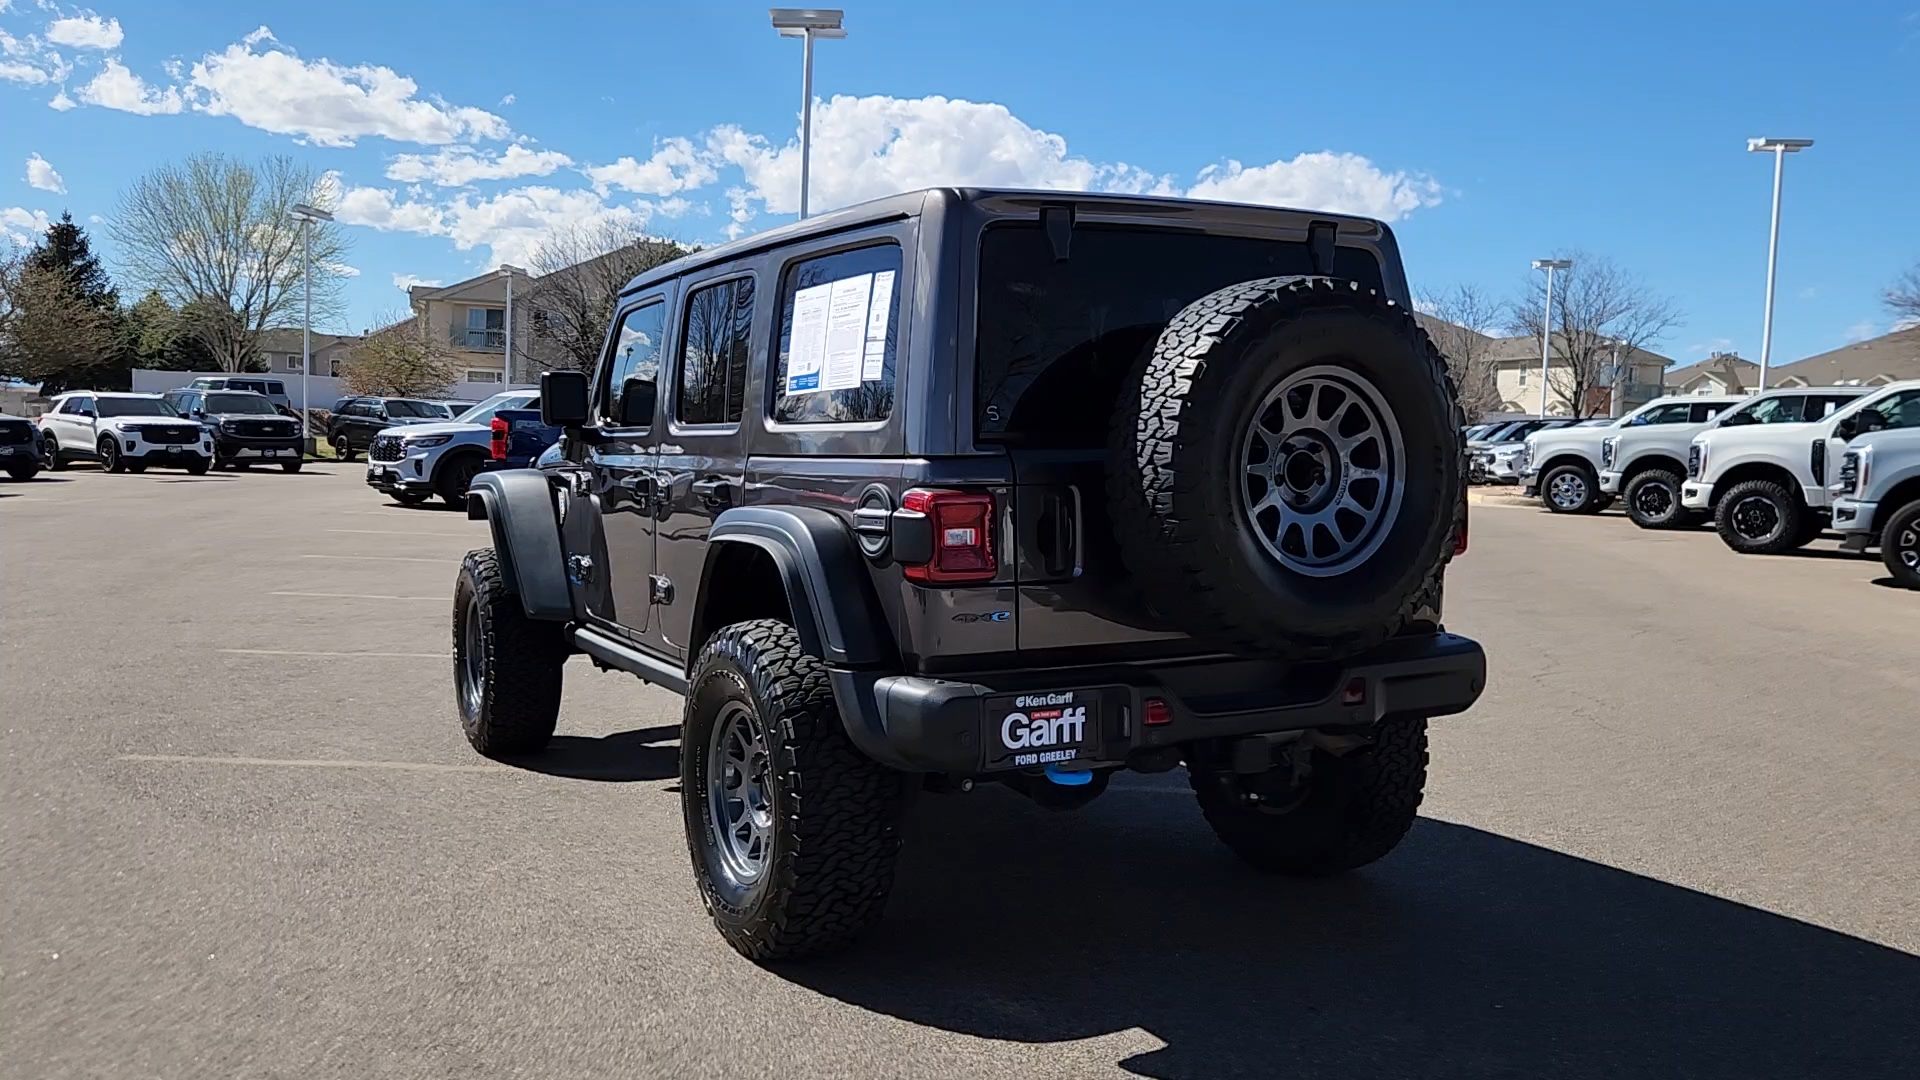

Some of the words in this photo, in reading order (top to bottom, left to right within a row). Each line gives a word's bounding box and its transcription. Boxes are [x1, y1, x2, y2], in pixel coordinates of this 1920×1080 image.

[1025, 695, 1047, 707] Ken
[1047, 692, 1073, 705] Garff
[1001, 706, 1086, 750] Garff
[1015, 753, 1038, 766] FORD
[1039, 749, 1077, 763] GREELEY
